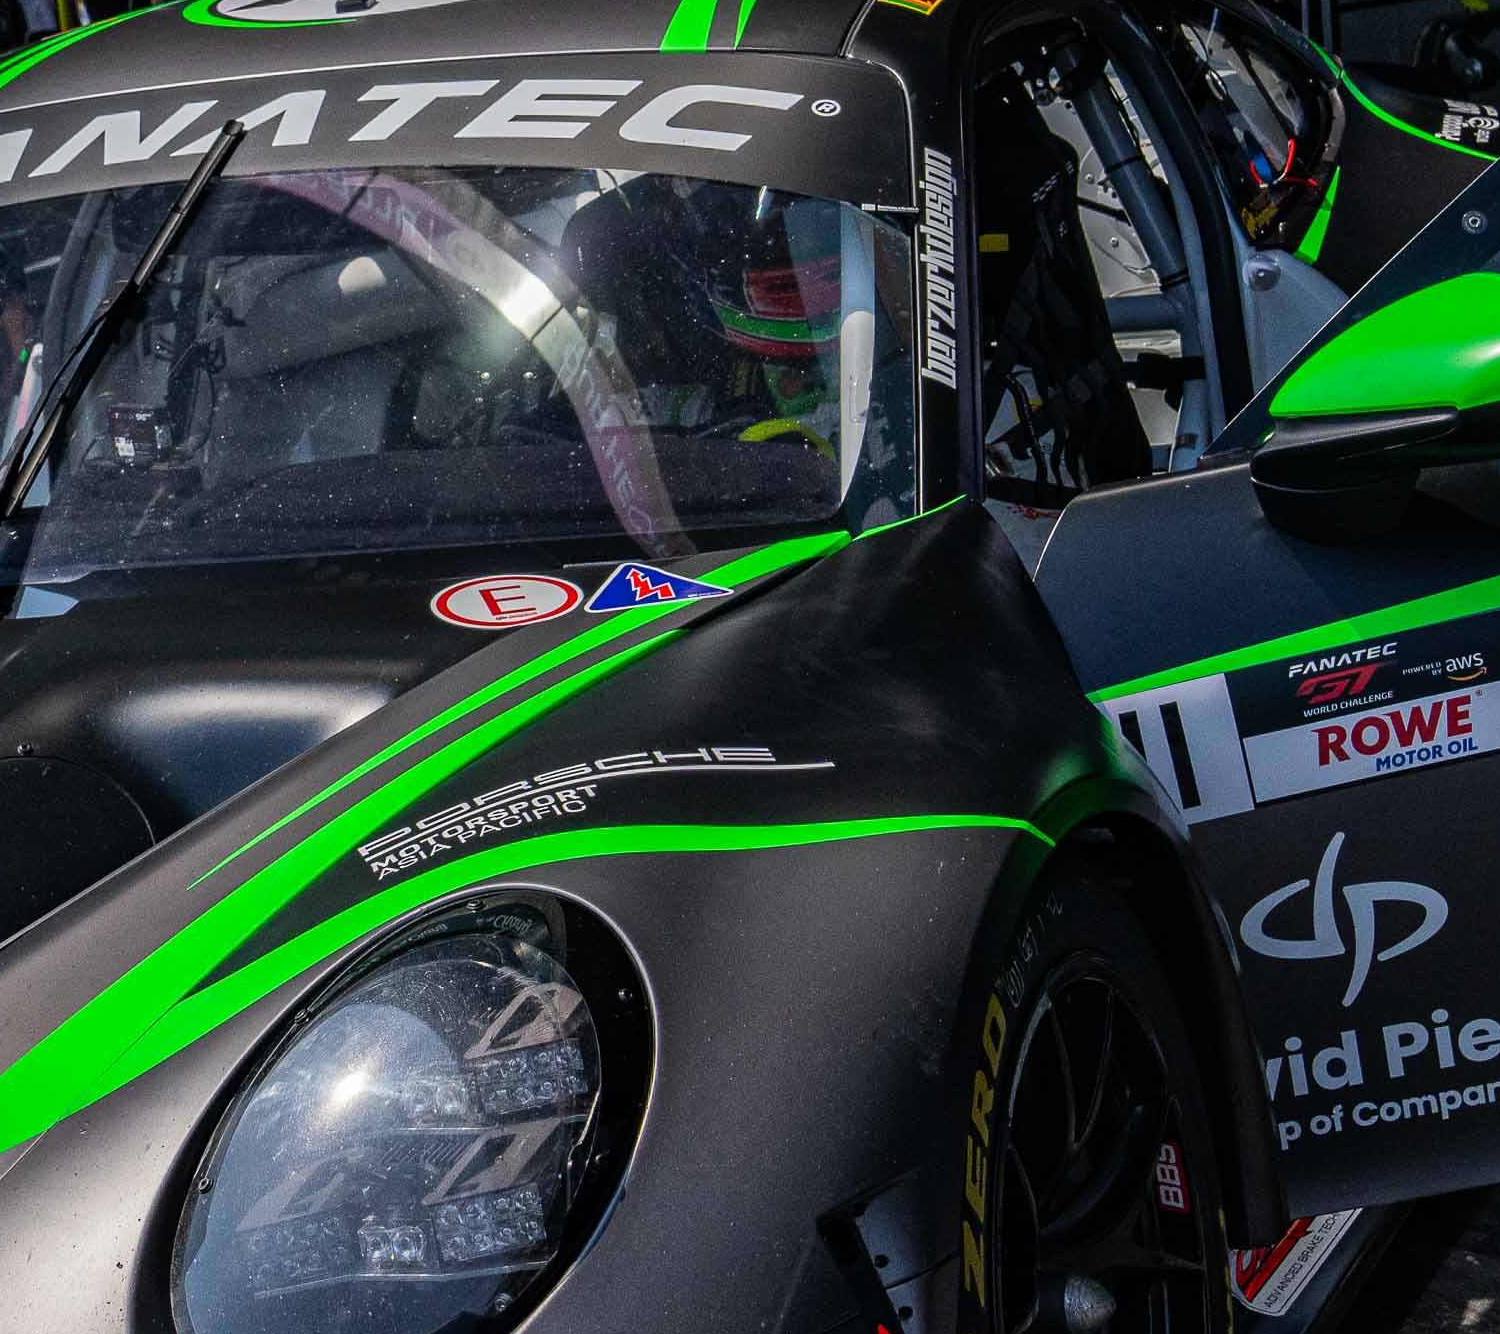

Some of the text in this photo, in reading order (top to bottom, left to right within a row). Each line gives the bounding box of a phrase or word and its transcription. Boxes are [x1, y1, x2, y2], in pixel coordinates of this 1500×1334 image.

[919, 147, 958, 389] berzerkdesign
[1288, 641, 1398, 679] FANATEC
[1445, 651, 1485, 673] aws
[1303, 690, 1395, 718] WORLD CHALLENGE
[1310, 694, 1473, 767] ROWE
[1375, 737, 1479, 772] MOTOR OIL
[357, 747, 777, 858] PORSCHE
[371, 784, 597, 873] MOTORSPORT
[378, 799, 588, 881] ASIA PACIFIC
[963, 992, 1007, 1308] ZERO
[1309, 1104, 1344, 1136] of
[1156, 1142, 1185, 1210] BBS
[1263, 1262, 1303, 1308] ADVANCED
[1297, 1234, 1325, 1264] BRAKE
